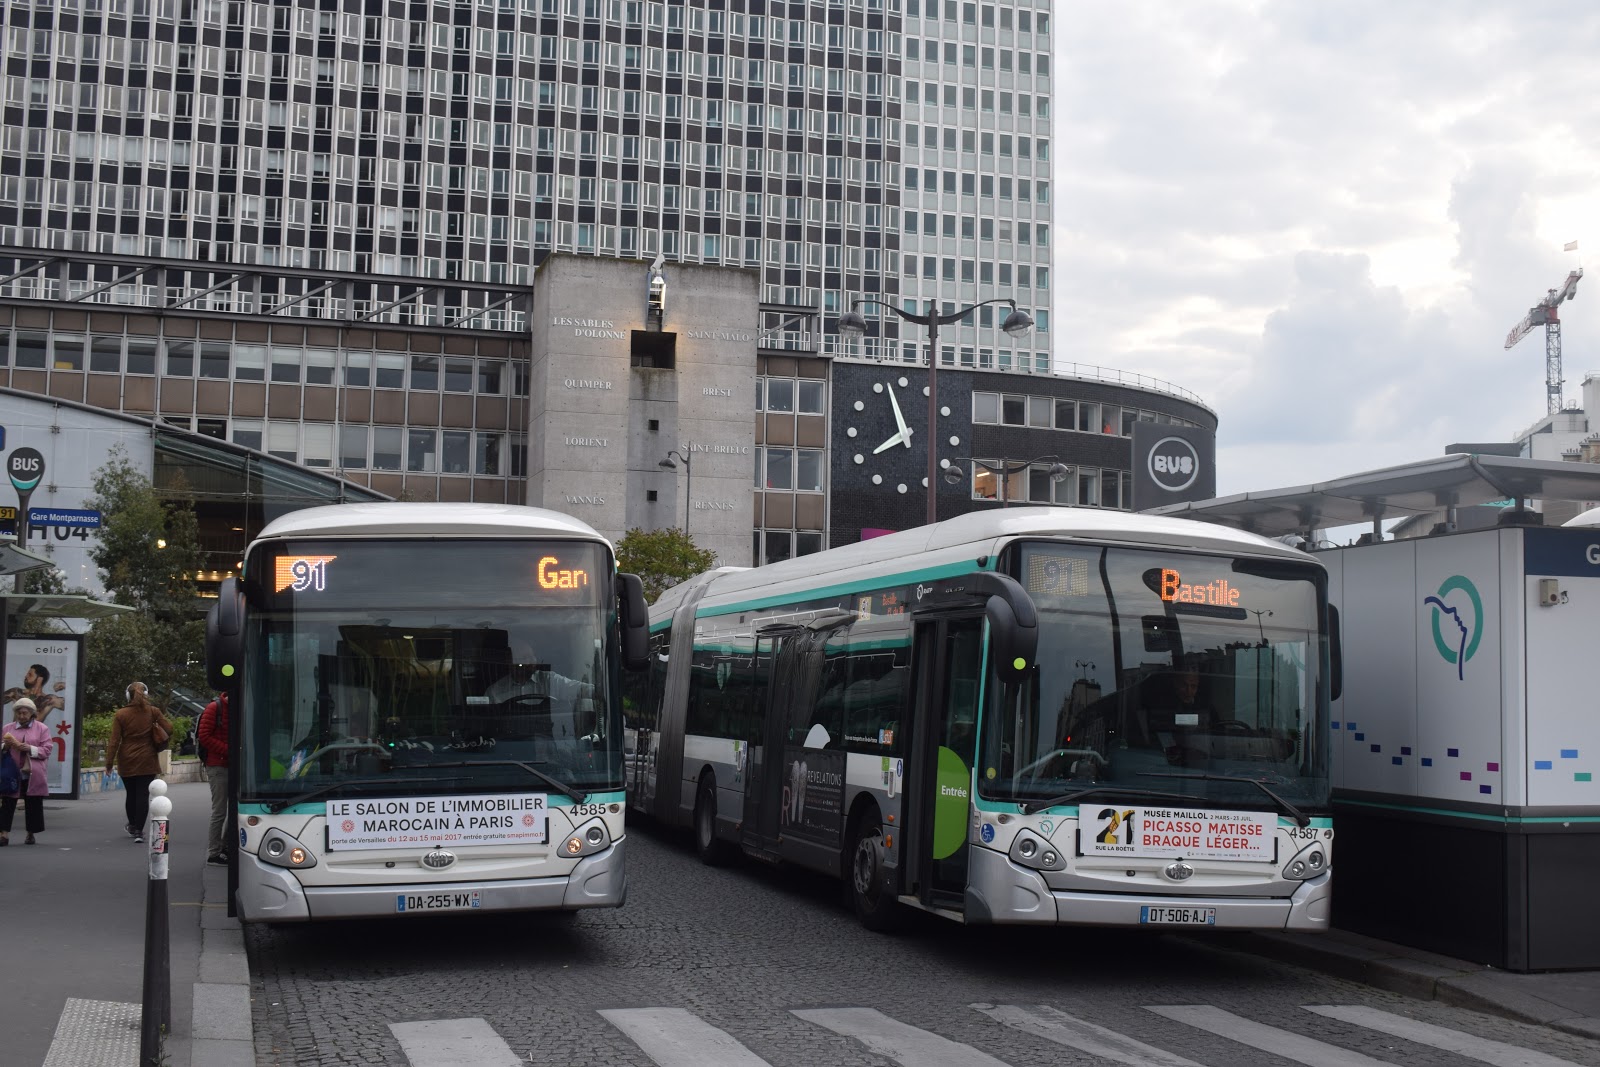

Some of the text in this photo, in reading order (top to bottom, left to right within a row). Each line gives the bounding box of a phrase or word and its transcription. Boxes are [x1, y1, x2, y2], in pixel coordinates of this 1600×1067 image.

[553, 317, 614, 328] LES SABLES
[575, 329, 626, 340] D'OLONNE
[687, 330, 750, 342] SAINT-MALO
[564, 379, 612, 390] QUIMPER
[702, 387, 732, 397] BREST
[565, 437, 608, 447] LORIENT
[682, 443, 749, 455] SAINT-BRIEUC
[12, 457, 39, 472] BUS
[1154, 455, 1193, 475] BUS
[565, 495, 605, 505] VANNES
[695, 501, 734, 511] RENNES
[0, 509, 13, 518] 91
[31, 512, 99, 524] Gare Montparnasse
[290, 558, 326, 592] 91
[537, 556, 588, 589] Gar
[1043, 559, 1074, 594] 91
[1160, 567, 1241, 607] Bastille
[941, 785, 968, 798] Entrée
[332, 798, 544, 816] LE SALON DE L'IMMOBILIER
[569, 803, 607, 817] 4585
[1143, 810, 1172, 819] MUSÉE
[1173, 811, 1209, 820] MAILLOL
[363, 813, 514, 832] MAROCAIN À PARIS
[1096, 807, 1136, 845] 21
[1143, 819, 1263, 836] PICASSO MATISSE
[358, 836, 387, 844] Versailles
[387, 835, 397, 843] du
[399, 834, 408, 842] 12
[420, 833, 429, 842] 15
[430, 833, 443, 841] mai
[444, 833, 462, 841] 2017
[463, 832, 482, 841] entrée
[483, 831, 506, 841] gratuite
[506, 830, 545, 839] smapimmo.fr
[1290, 827, 1319, 840] 4587
[1143, 834, 1261, 851] BRAQUE LÉGER...
[407, 893, 470, 910] DA-255-WX
[1150, 909, 1207, 924] DT-506-AJ
[1208, 915, 1215, 925] 75
